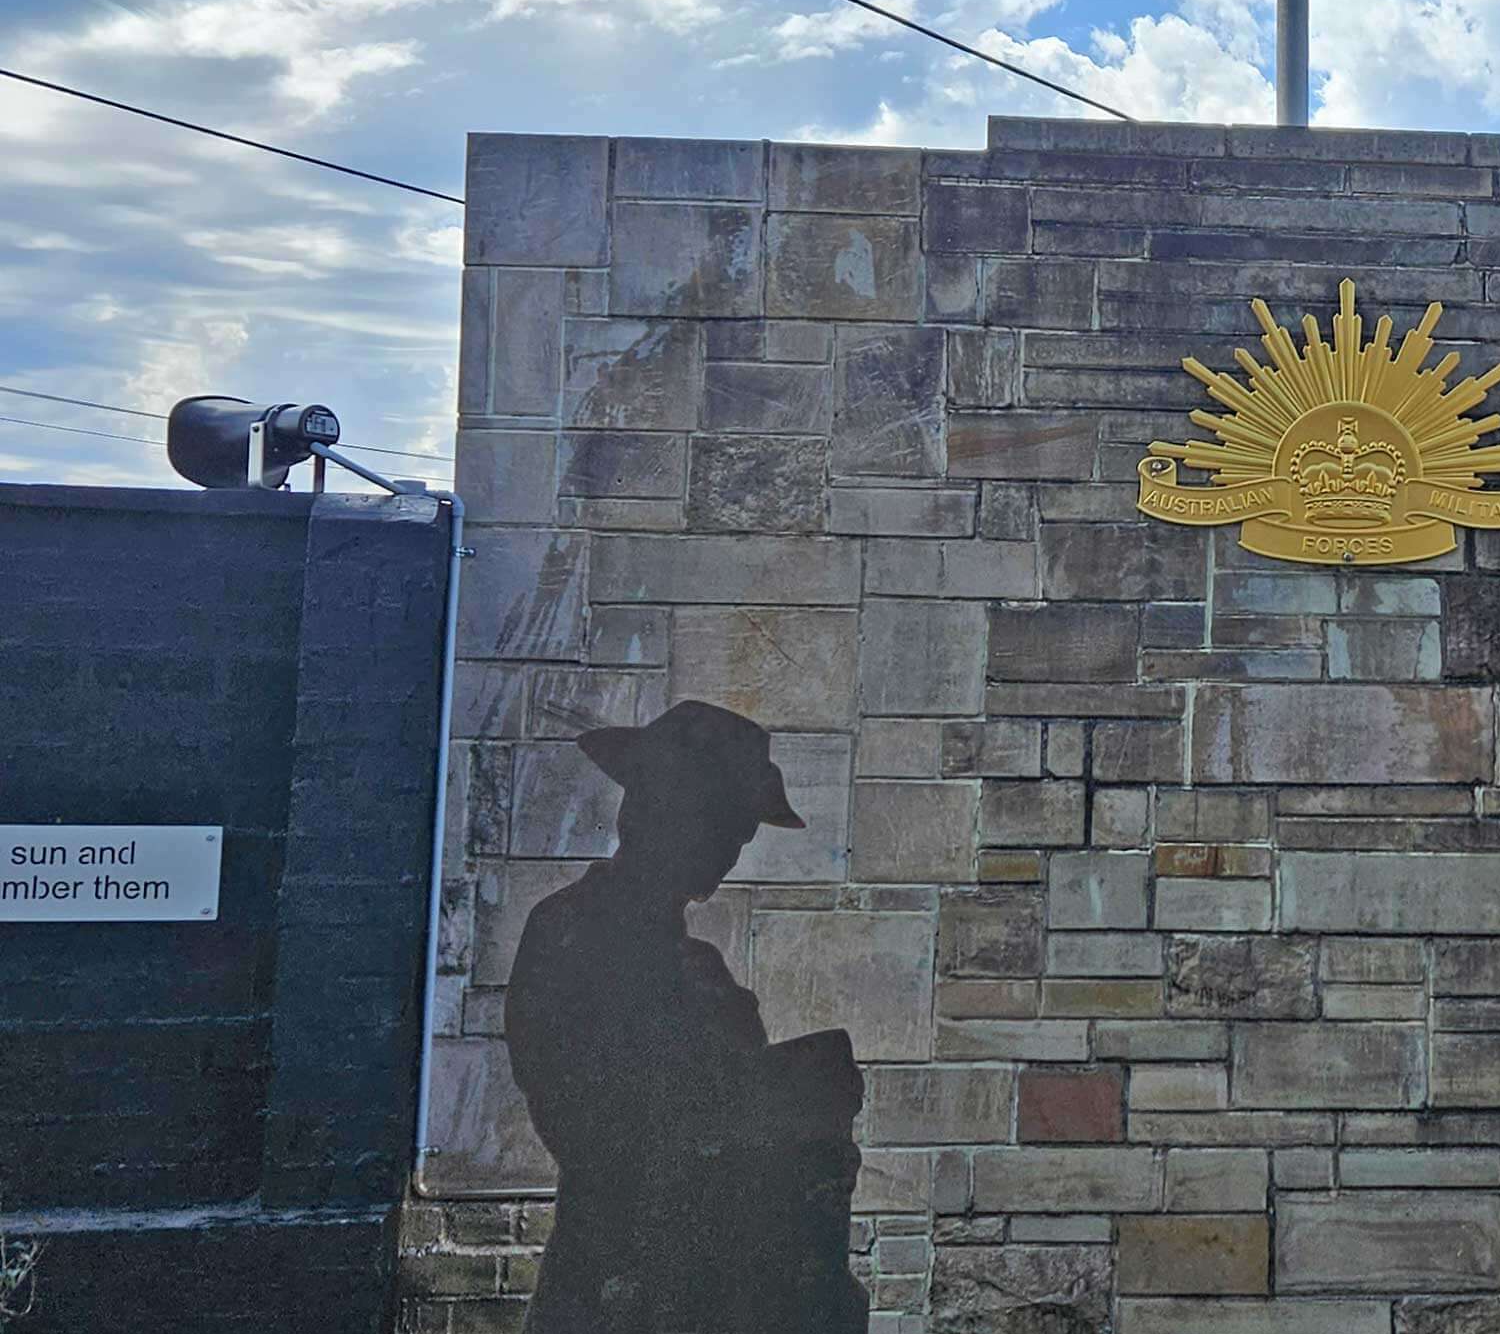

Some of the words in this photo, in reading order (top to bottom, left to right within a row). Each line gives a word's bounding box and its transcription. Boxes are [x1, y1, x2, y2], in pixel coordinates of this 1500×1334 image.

[1143, 486, 1275, 516] AUSTRALIAN
[1302, 535, 1394, 555] FORCES
[11, 845, 66, 865] sun
[78, 840, 136, 865] and
[1, 874, 84, 900] mber
[93, 874, 170, 900] them
